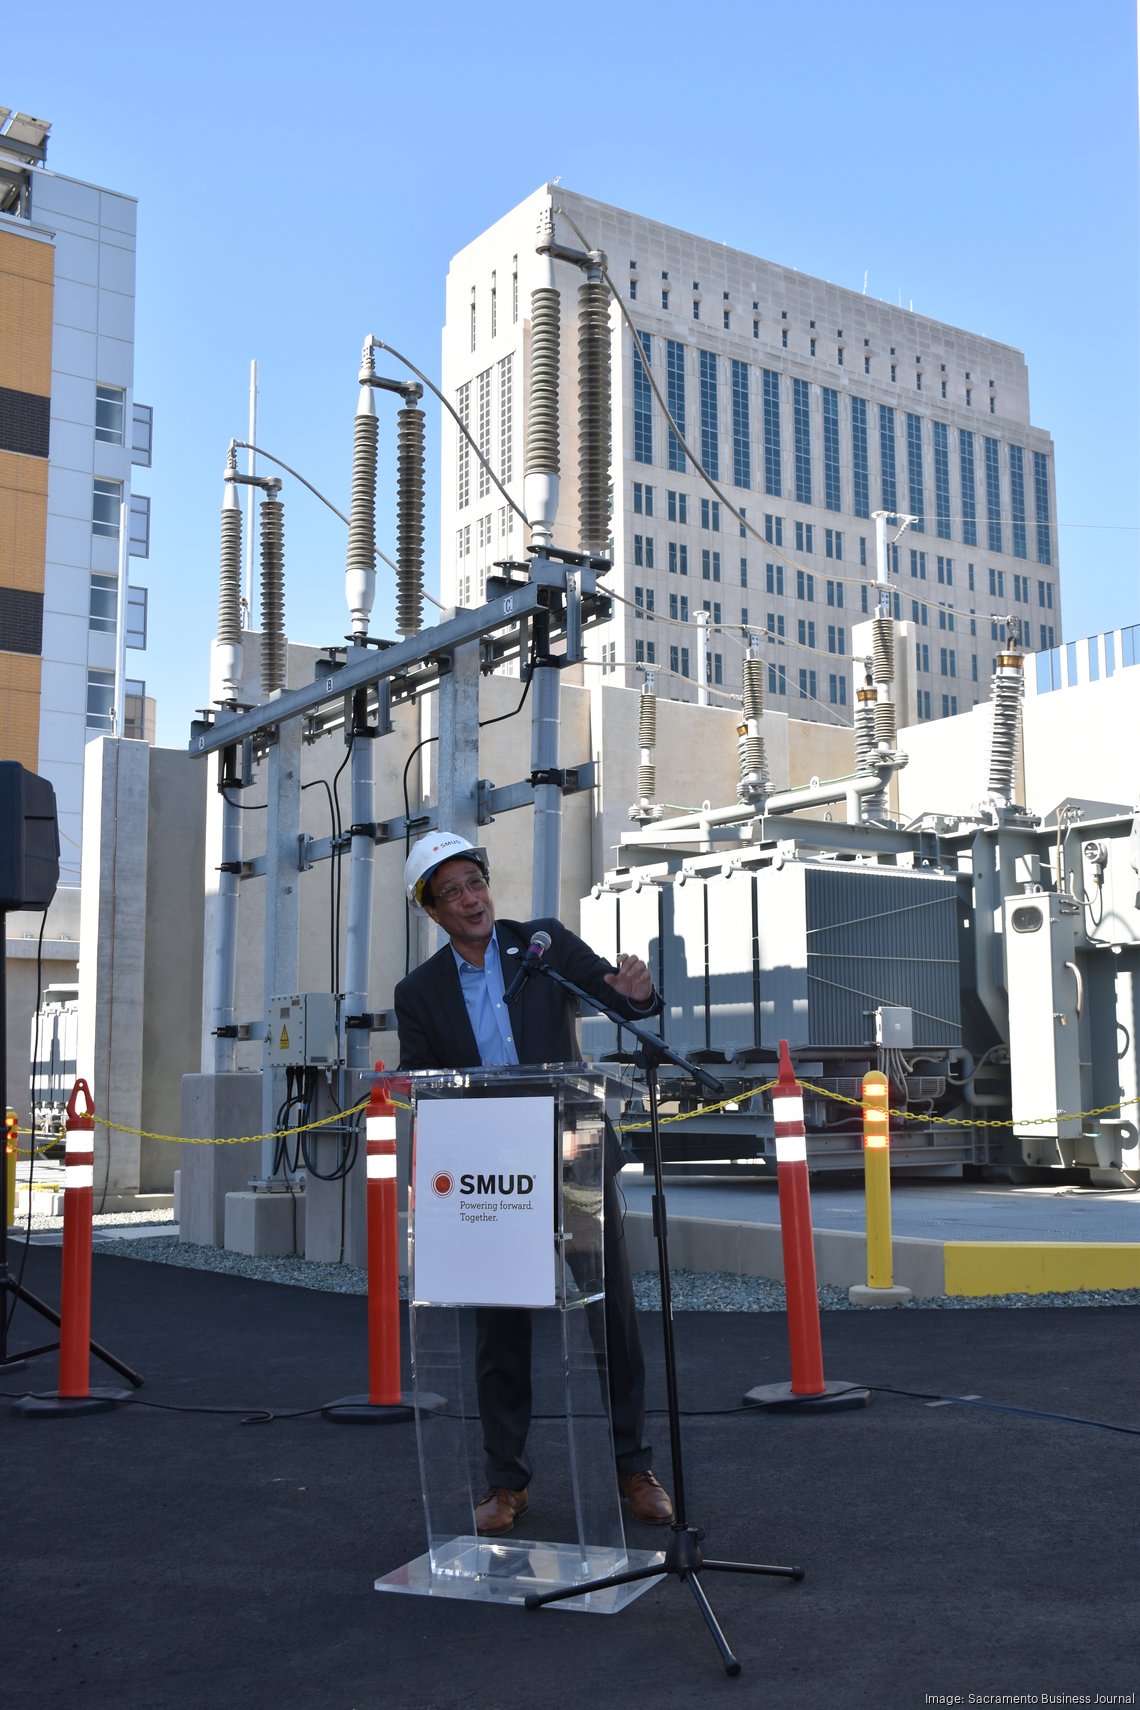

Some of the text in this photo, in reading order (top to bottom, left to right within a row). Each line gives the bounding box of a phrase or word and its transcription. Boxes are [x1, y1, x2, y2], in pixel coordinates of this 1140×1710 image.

[440, 840, 461, 848] SMUD
[460, 1201, 534, 1211] Powering forward.
[460, 1213, 498, 1223] Together.
